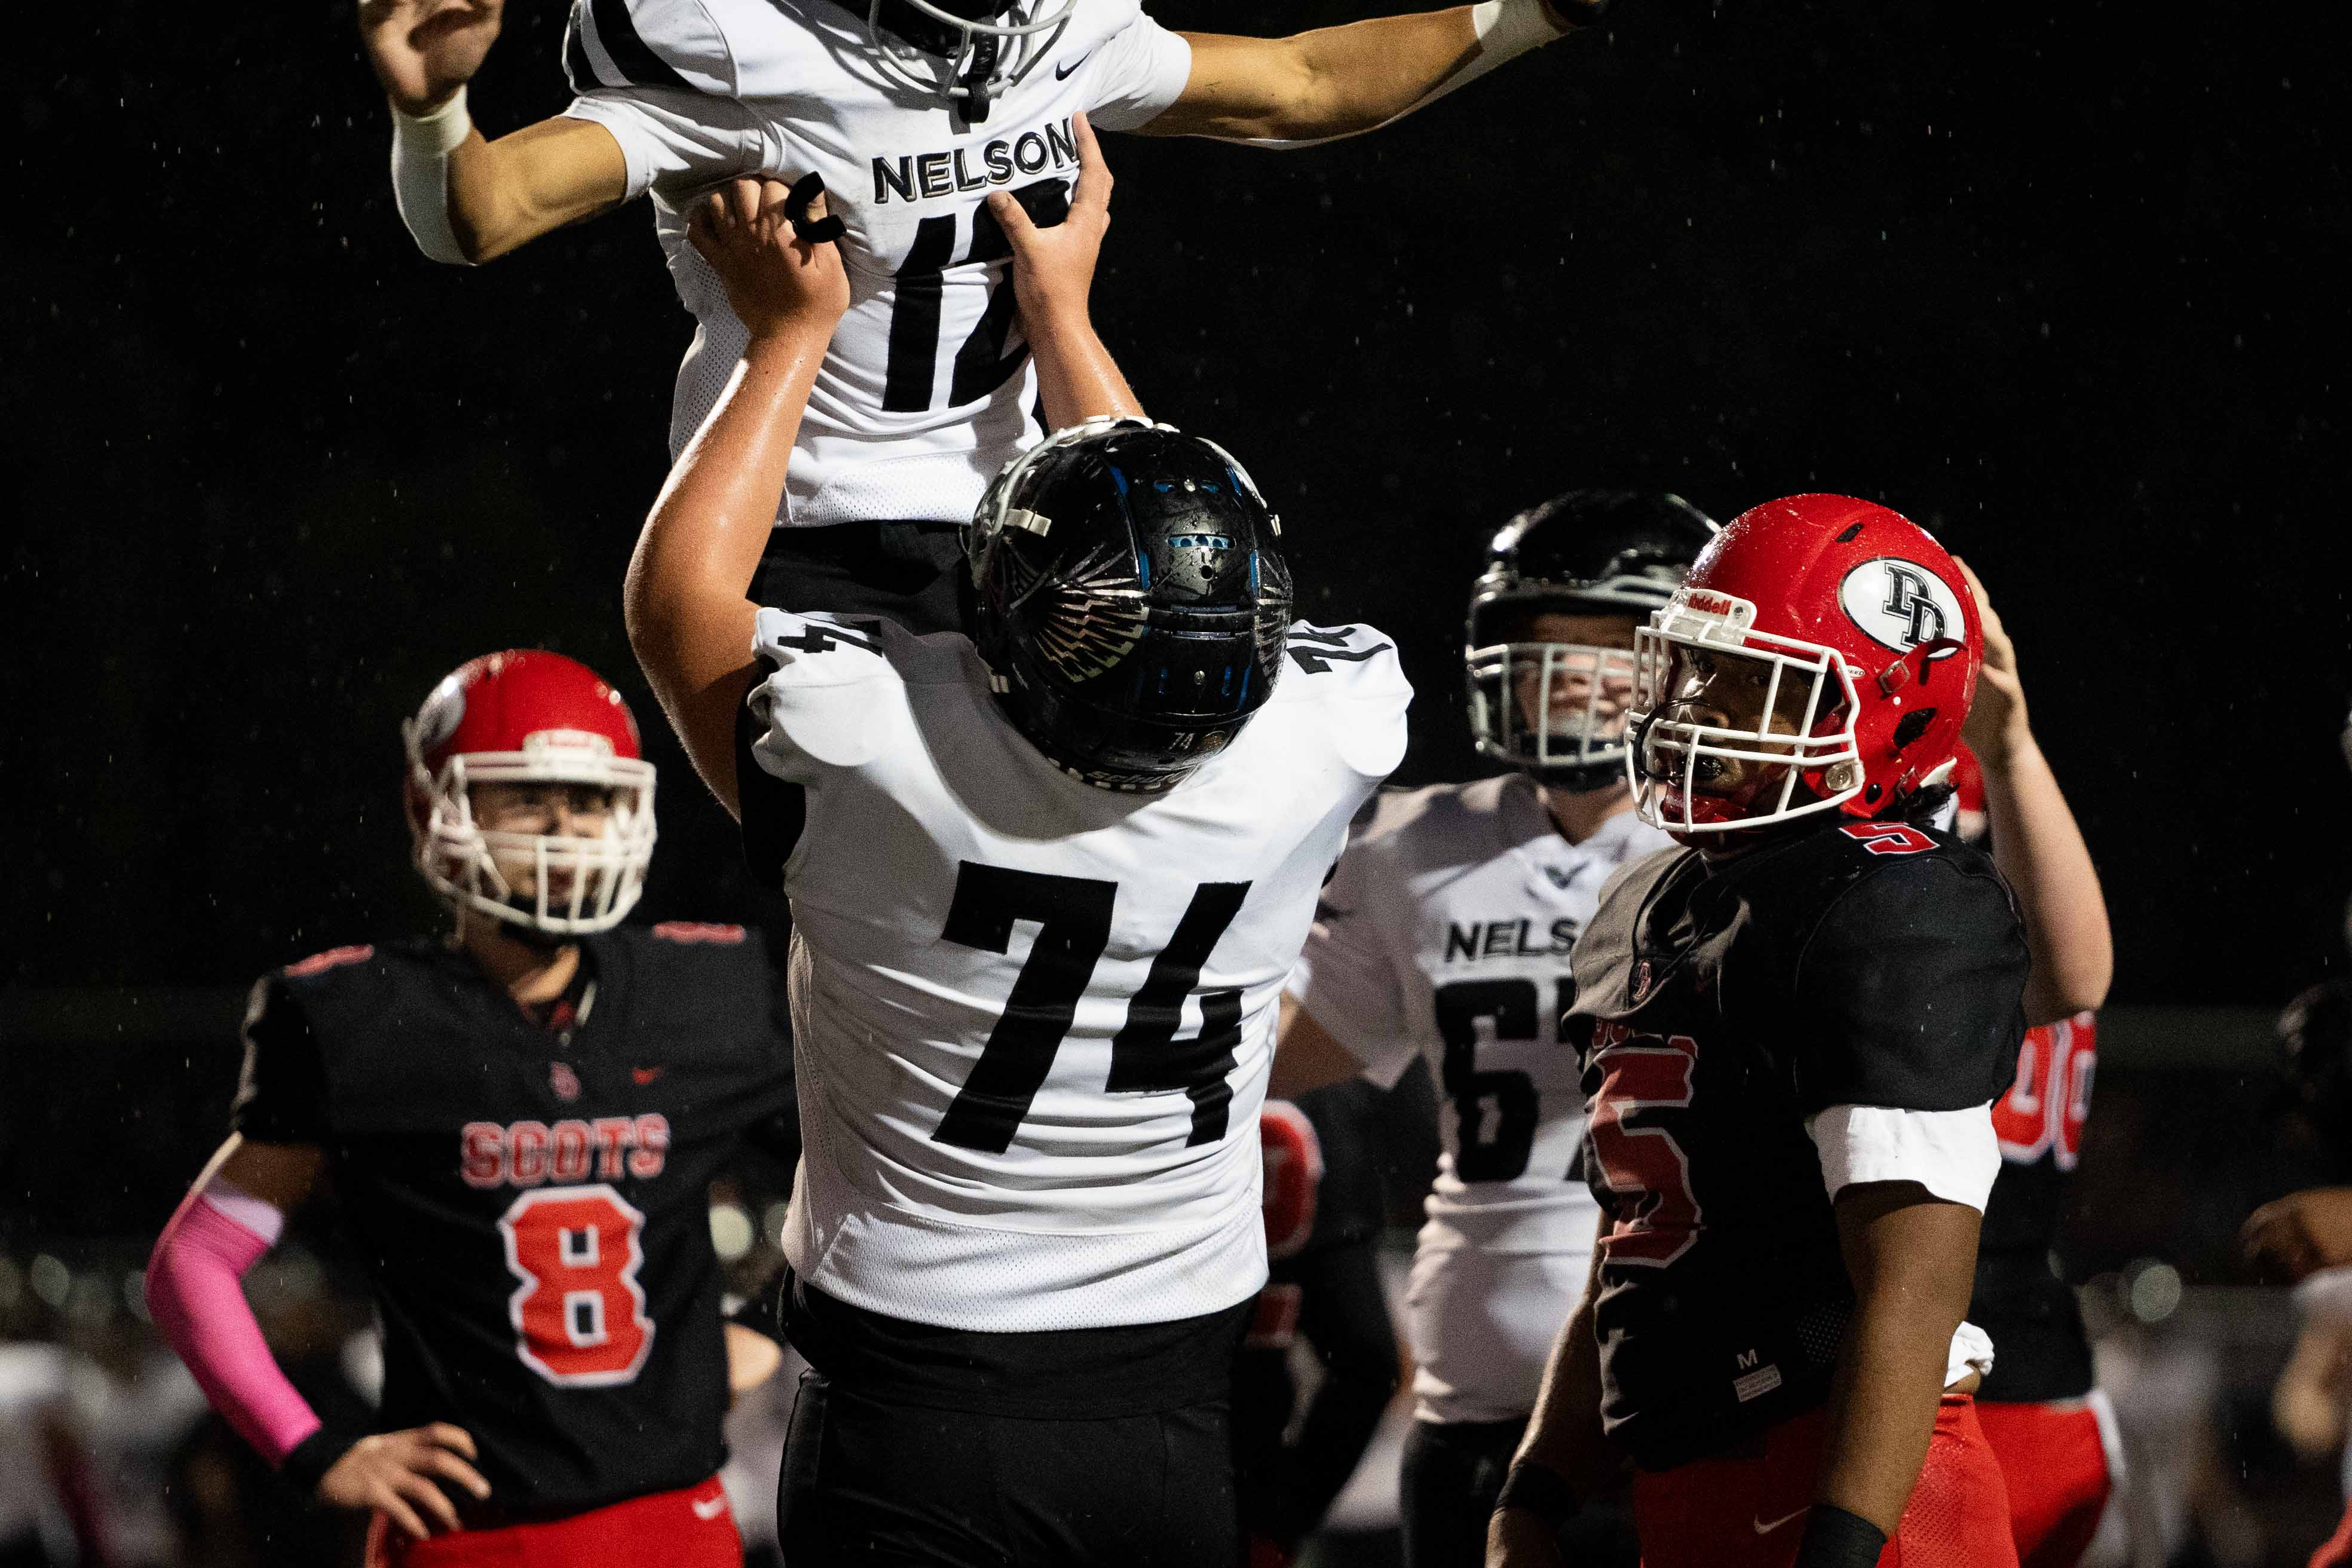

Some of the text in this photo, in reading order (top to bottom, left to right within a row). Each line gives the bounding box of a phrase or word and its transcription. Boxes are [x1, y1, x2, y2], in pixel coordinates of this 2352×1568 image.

[872, 118, 1079, 204] NELSON
[1445, 918, 1578, 963] NELS
[932, 860, 1253, 1153] 74
[461, 1113, 670, 1187] SCOTS
[1590, 1046, 1703, 1268] 5
[497, 1184, 656, 1388] 8
[1737, 1348, 1758, 1369] M
